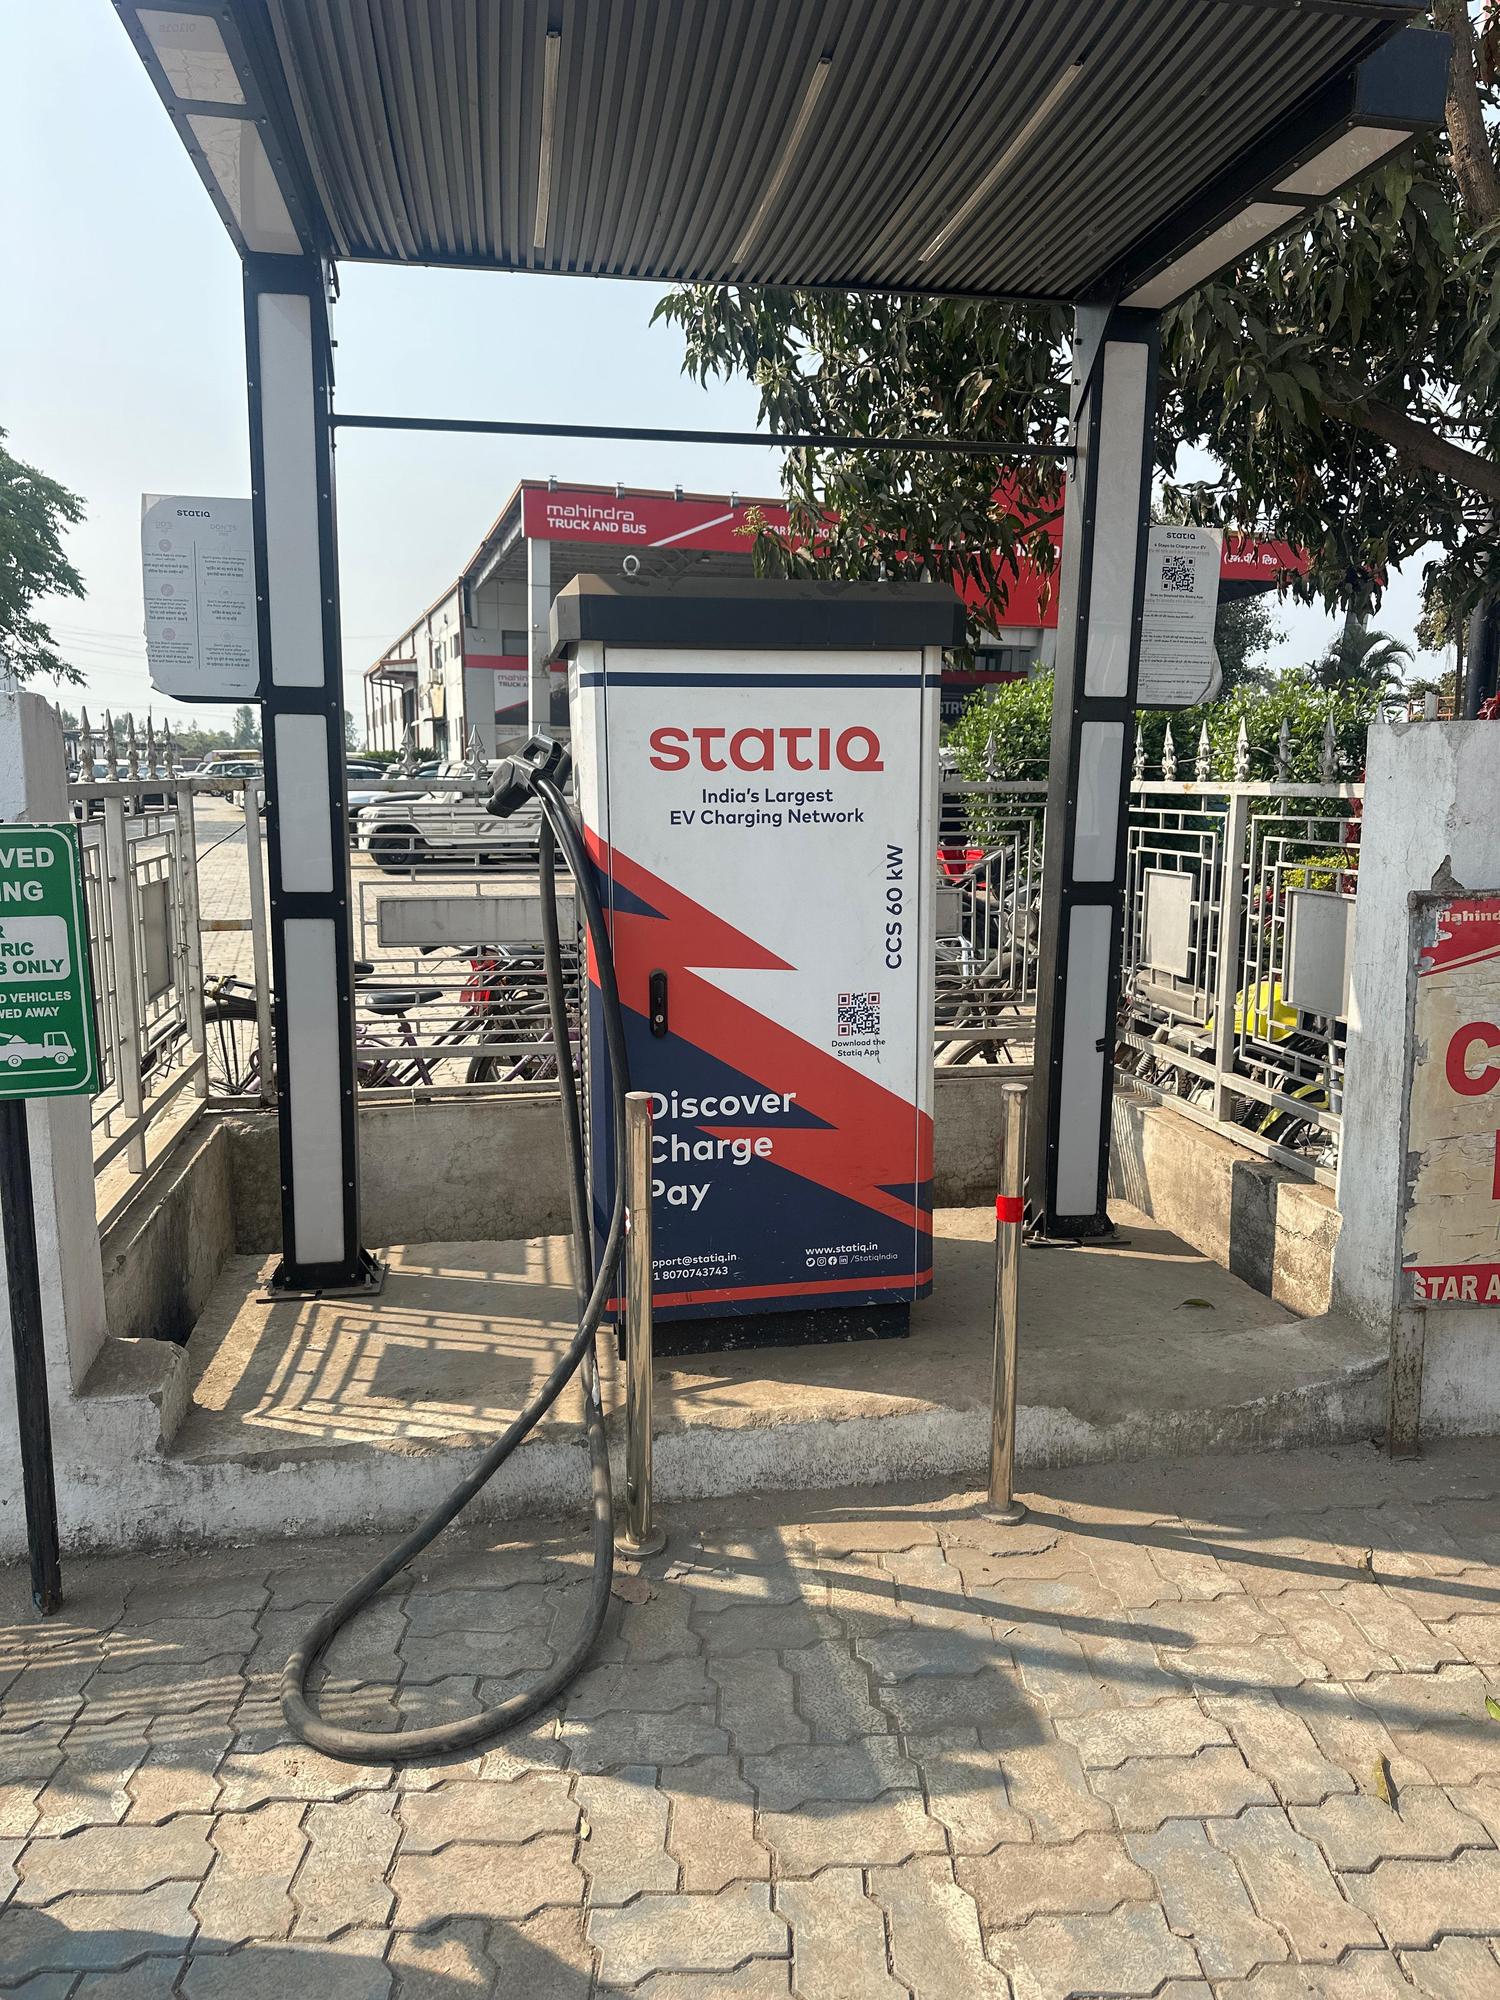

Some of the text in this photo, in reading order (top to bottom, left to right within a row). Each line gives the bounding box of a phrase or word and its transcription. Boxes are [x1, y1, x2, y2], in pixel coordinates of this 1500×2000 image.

[547, 504, 635, 521] mahindra
[547, 517, 647, 535] TRUCK AND BUS
[702, 788, 833, 806] India's Largest
[669, 808, 864, 828] EV Charging Network
[0, 881, 44, 902] NG
[885, 844, 903, 969] CCS 60 kW
[1, 942, 34, 957] RIC
[13, 959, 65, 975] ONLY
[9, 991, 72, 1003] VEHICLES
[25, 1006, 60, 1018] AWAY
[832, 1038, 886, 1048] Download the
[838, 1048, 880, 1057] Statiq App
[652, 1090, 797, 1120] Discover
[652, 1133, 773, 1166] Charge
[652, 1179, 711, 1212] Pay
[805, 1242, 878, 1255] www.statiq.in
[850, 1252, 898, 1264] /StatiqIndia
[662, 1266, 729, 1280] 8070743743
[1415, 1275, 1478, 1301] STAR
